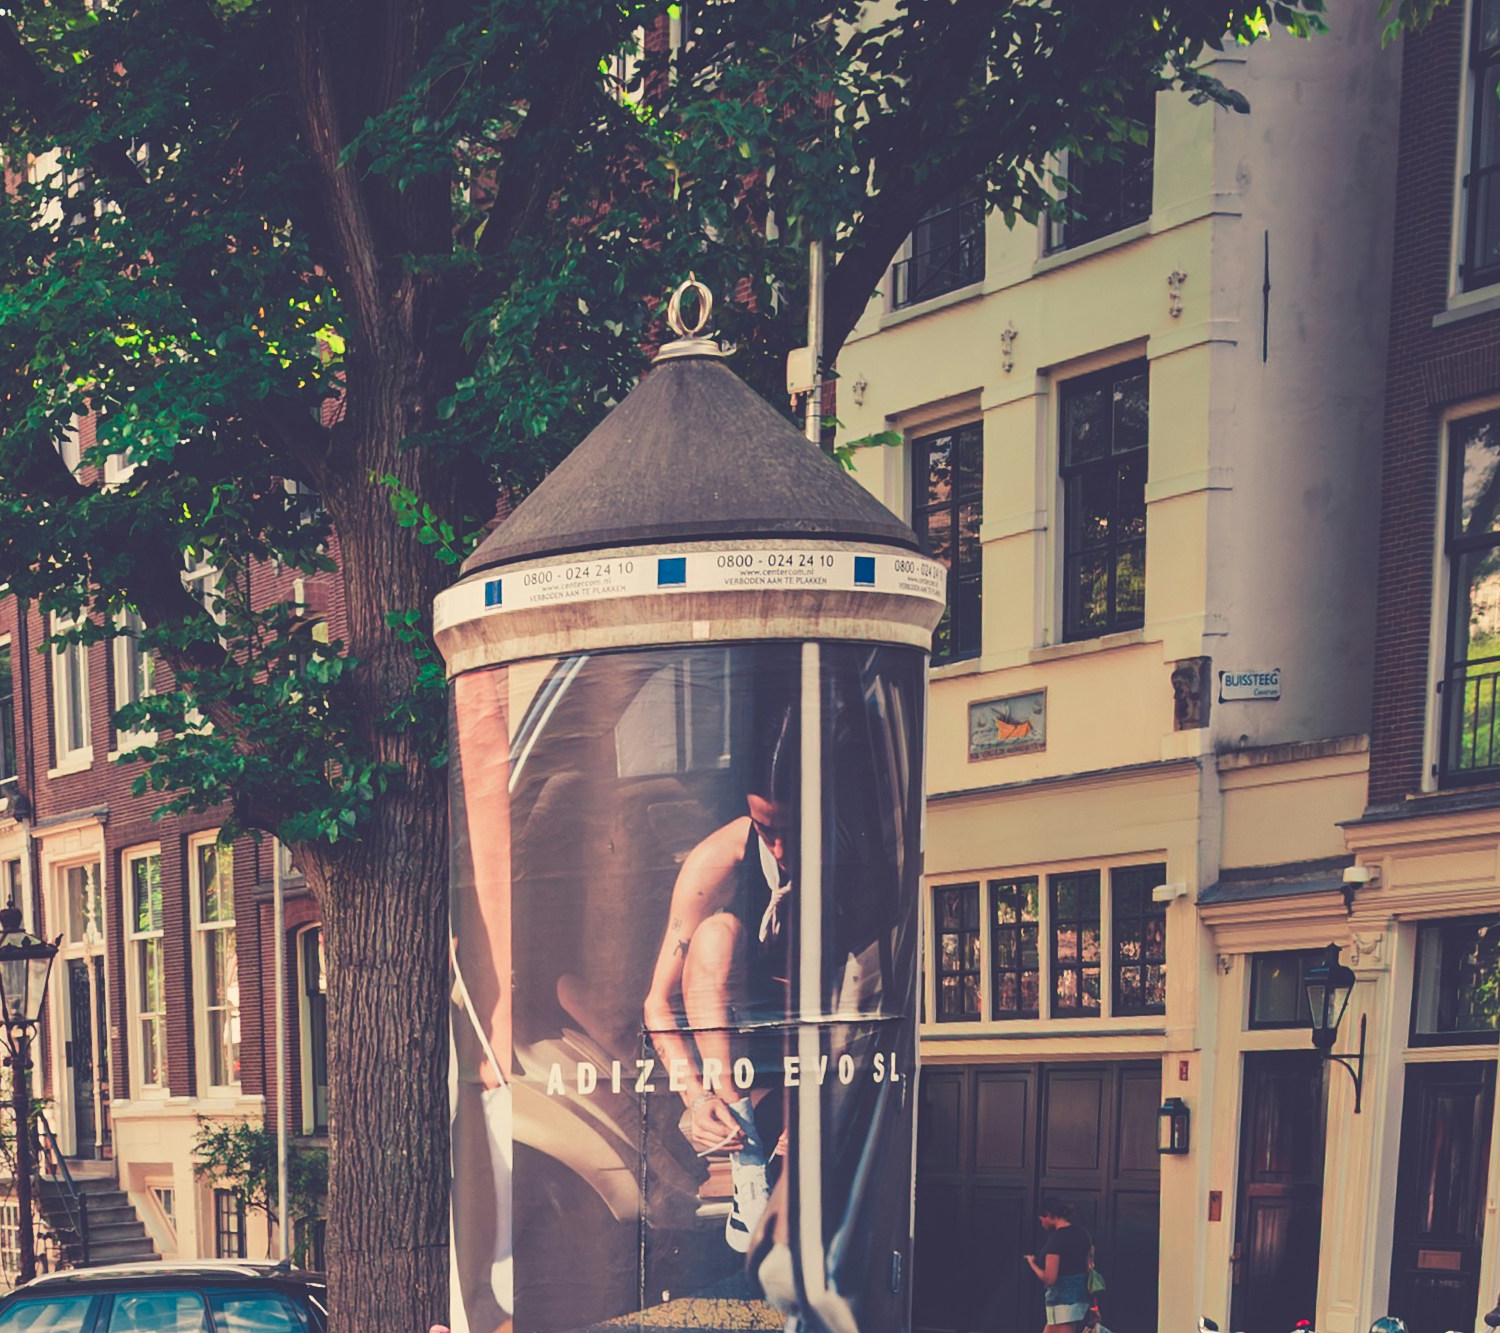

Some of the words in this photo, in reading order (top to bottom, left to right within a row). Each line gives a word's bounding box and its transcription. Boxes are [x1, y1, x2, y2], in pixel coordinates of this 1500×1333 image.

[717, 554, 753, 567] 0800
[767, 554, 793, 567] 024
[799, 554, 814, 567] 24
[820, 554, 834, 567] 10
[895, 559, 914, 573] 0800
[523, 570, 553, 586] 0800
[565, 566, 590, 581] 024
[595, 563, 611, 577] 24
[618, 561, 634, 575] 10
[740, 568, 814, 576] www.centercom.nl
[724, 577, 765, 585] VERBODEN
[785, 577, 795, 585] TE
[796, 577, 827, 585] PLAKKEN
[1225, 673, 1279, 687] BUISSTEEG
[546, 1057, 755, 1096] ADIZERO
[783, 1054, 855, 1088] EVO
[873, 1052, 900, 1083] SL
